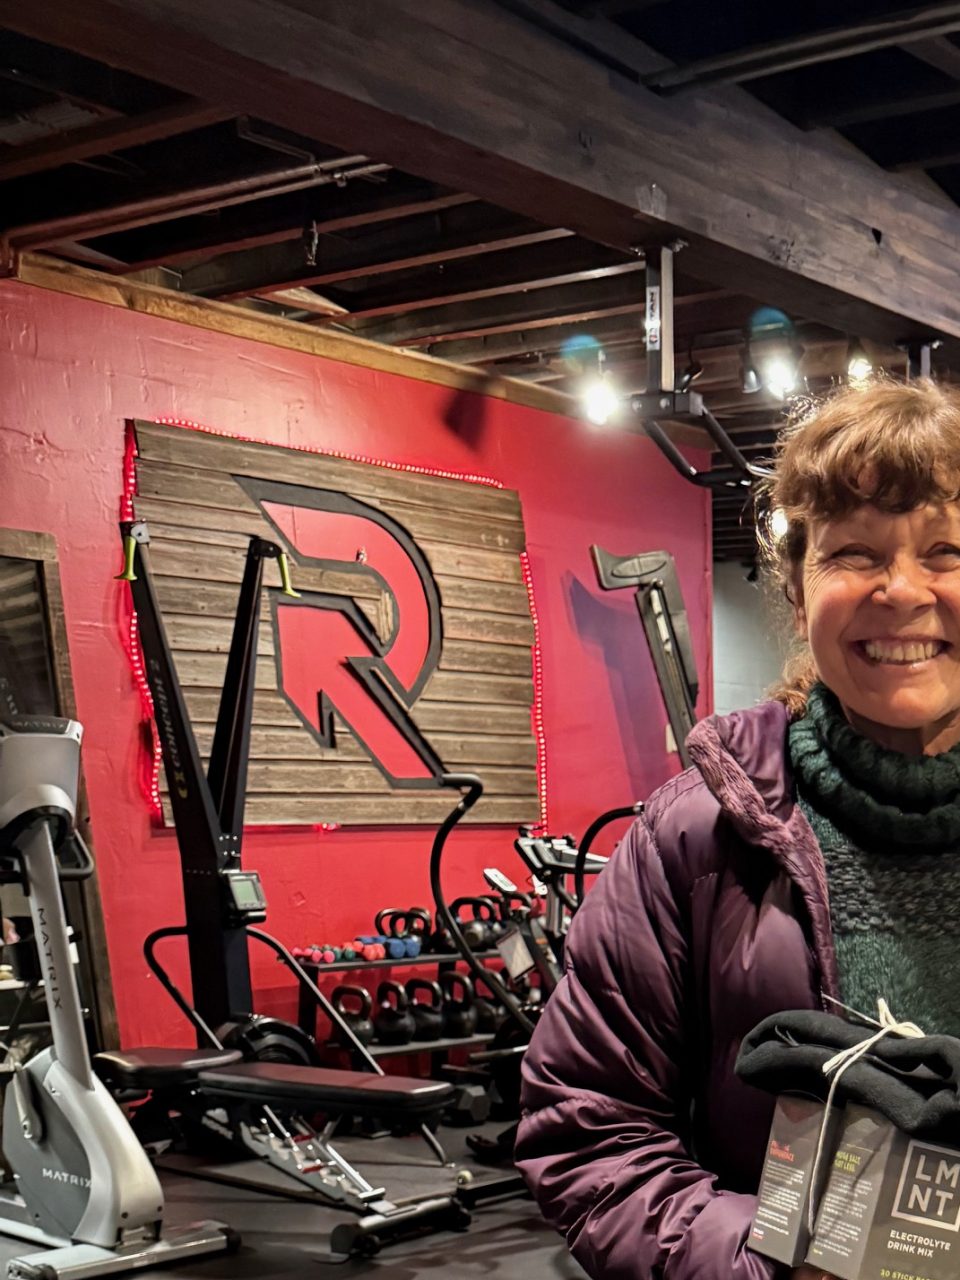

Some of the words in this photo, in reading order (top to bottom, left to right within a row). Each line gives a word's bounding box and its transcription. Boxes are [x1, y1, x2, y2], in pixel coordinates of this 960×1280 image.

[37, 908, 63, 1009] MATRIX
[42, 1168, 91, 1188] MATRIX
[887, 1240, 915, 1254] DRINK
[917, 1246, 934, 1258] MIX
[889, 1229, 951, 1251] ELECTROLYTE
